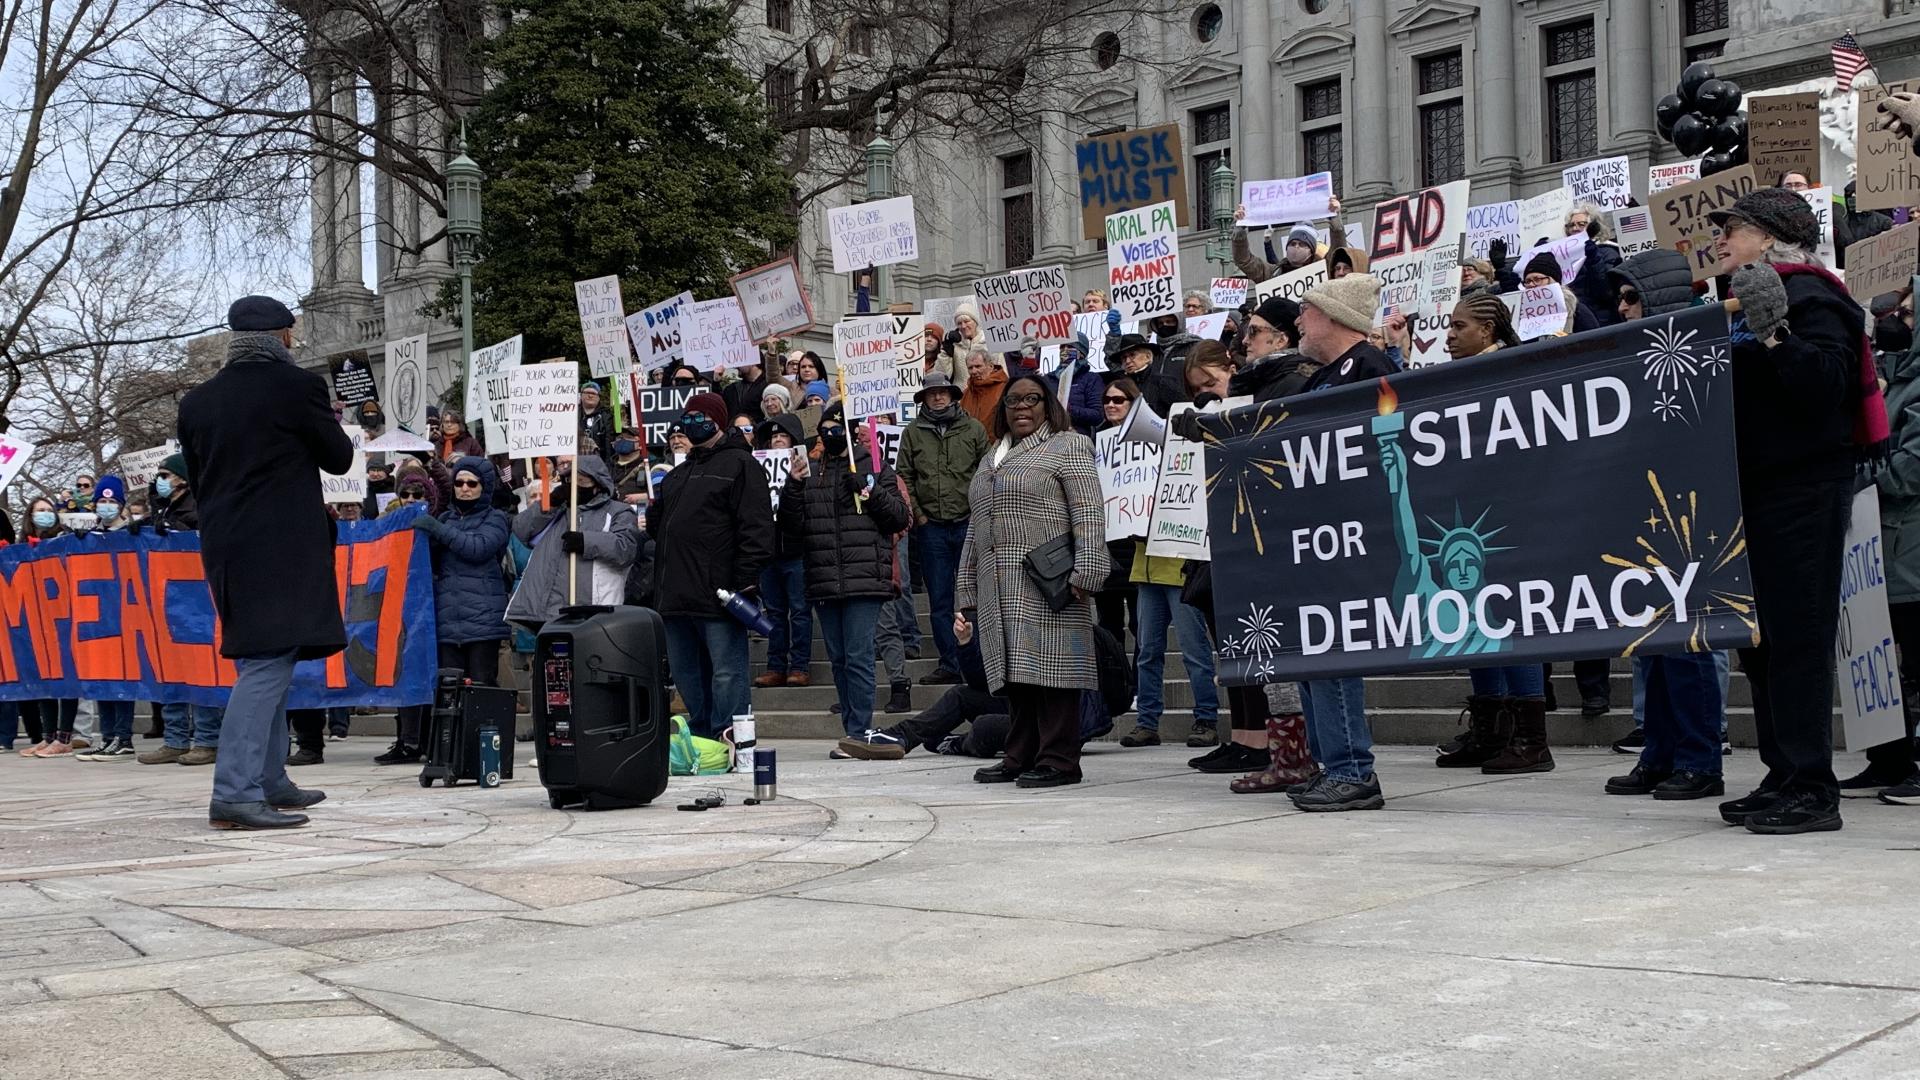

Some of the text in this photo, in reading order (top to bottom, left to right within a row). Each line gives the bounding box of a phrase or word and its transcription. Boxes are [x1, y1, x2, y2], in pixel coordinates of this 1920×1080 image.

[1076, 131, 1173, 174] MUSK
[1867, 138, 1908, 161] why
[1755, 157, 1770, 166] We
[1794, 154, 1806, 164] All
[1564, 166, 1591, 186] TRUMP
[1593, 173, 1625, 191] LOOTING
[1651, 165, 1695, 179] STUDENTS
[1080, 165, 1178, 208] MUST
[1248, 180, 1305, 200] PLEASE
[1609, 192, 1631, 212] YOU
[1665, 175, 1753, 227] STAND
[1106, 206, 1175, 246] RURAL PA
[1371, 190, 1446, 260] END
[1121, 235, 1170, 264] VOTERS
[1435, 249, 1458, 261] TRANS
[1620, 240, 1658, 254] WE ARE
[1846, 240, 1878, 273] GET
[1893, 247, 1917, 263] WHITE
[1111, 254, 1176, 286] AGAINST
[1433, 259, 1458, 272] RIGHTS
[1892, 261, 1917, 281] HOUSE
[578, 281, 613, 299] MEN OF
[974, 267, 1065, 300] REPUBLICANS
[1112, 276, 1173, 304] PROJECT
[1212, 278, 1231, 289] ACT
[580, 297, 617, 318] QUALITY
[981, 299, 1017, 322] MUST
[1027, 291, 1063, 314] STOP
[1131, 292, 1175, 317] 2025
[1215, 295, 1240, 304] LATER
[594, 317, 605, 328] NOT
[608, 316, 625, 327] FEAR
[838, 322, 892, 341] PROTECT OUR
[987, 310, 1072, 342] THIS COUP
[585, 329, 626, 346] EQUALITY
[685, 335, 717, 352] NEVER
[846, 336, 892, 359] CHILDREN
[395, 339, 419, 367] NOT
[599, 346, 614, 358] FOR
[704, 354, 715, 369] IS
[511, 368, 576, 381] IF YOUR VOICE
[843, 357, 896, 376] PROTECT THE
[510, 385, 577, 398] HELD NO POWER
[844, 378, 890, 396] DEPARTMENT
[511, 403, 533, 414] THEY
[512, 419, 553, 431] TRY TO
[1281, 375, 1632, 489] WE STAND
[511, 434, 552, 450] SILENCE
[1167, 452, 1195, 472] LGBT
[1160, 483, 1198, 504] BLACK
[1157, 520, 1204, 542] IMMIGRANT
[1291, 520, 1367, 564] FOR
[1299, 561, 1700, 656] DEMOCRACY
[0, 552, 239, 687] MPEAC
[1851, 637, 1900, 718] PEACE
